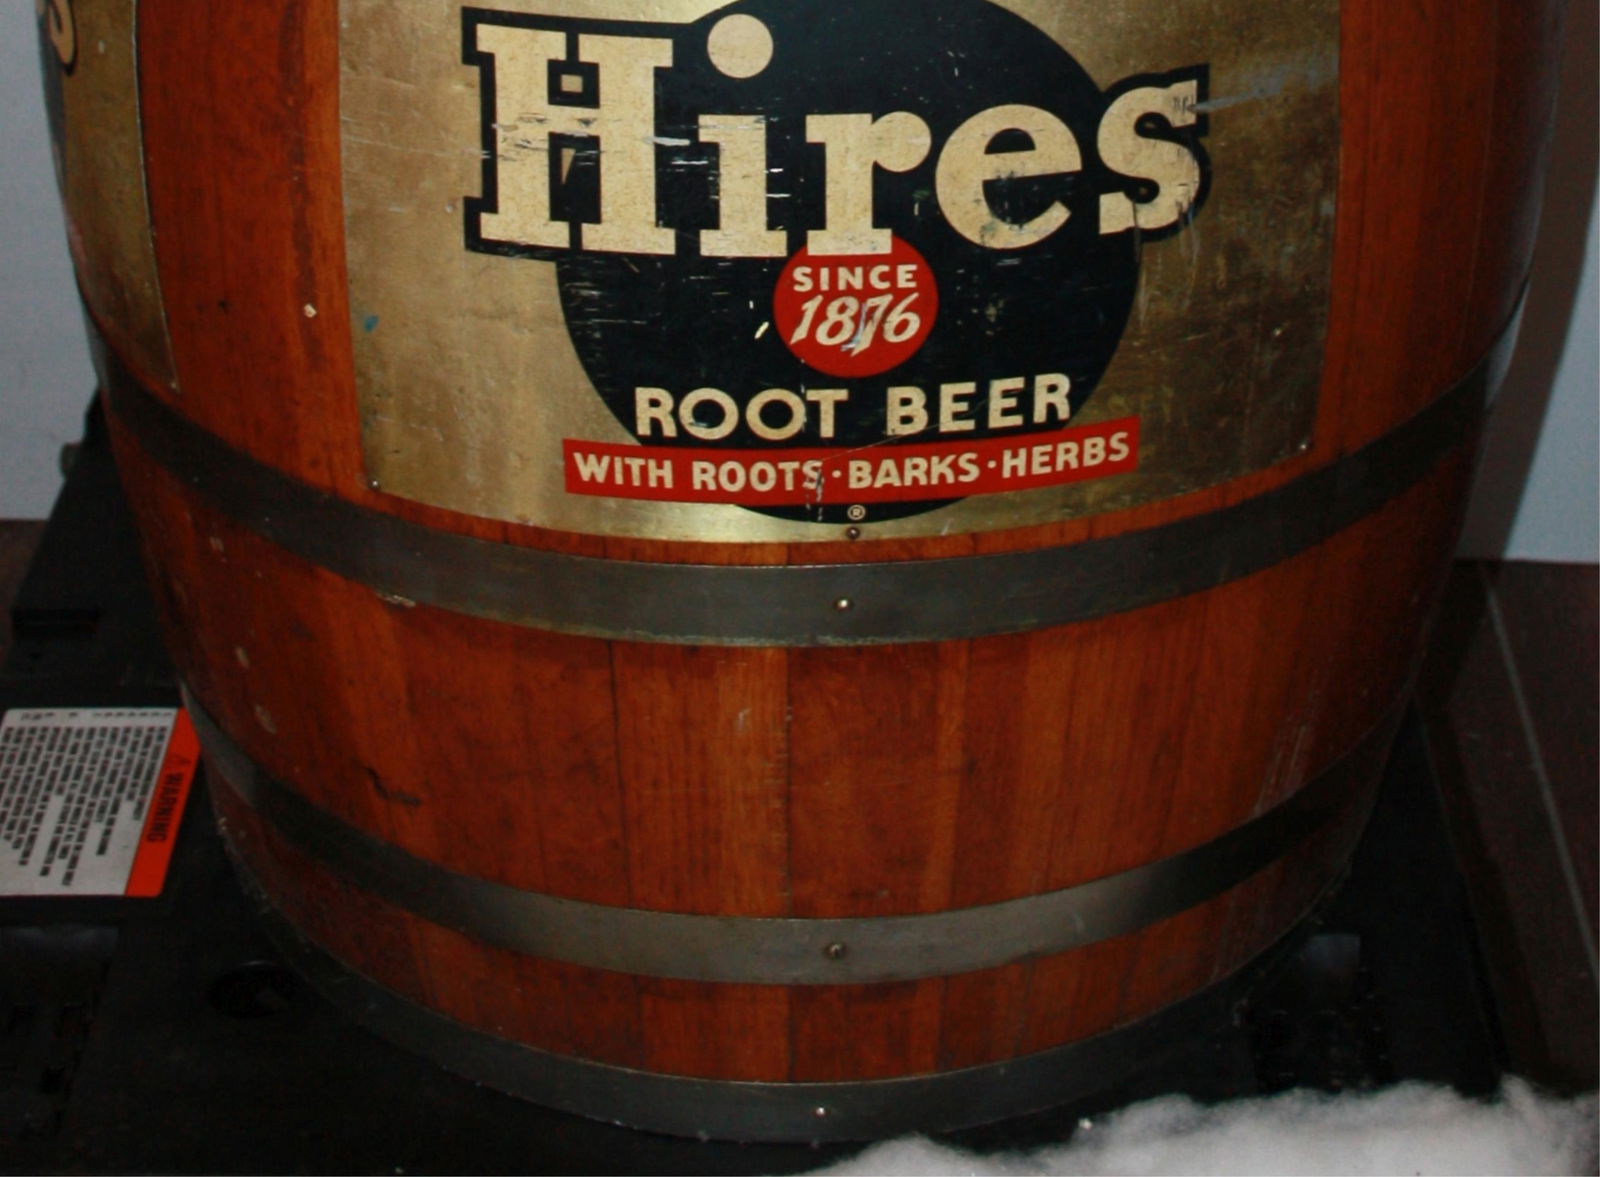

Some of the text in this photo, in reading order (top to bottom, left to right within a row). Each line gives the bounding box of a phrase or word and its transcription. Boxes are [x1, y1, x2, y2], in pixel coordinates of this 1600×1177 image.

[476, 13, 1199, 256] Hires
[793, 264, 918, 292] SINCE
[790, 292, 921, 357] 1876
[634, 373, 1071, 442] ROOT BEER
[573, 454, 674, 489] WITH
[1001, 433, 1130, 476] HERBS
[147, 772, 183, 843] WARNING
